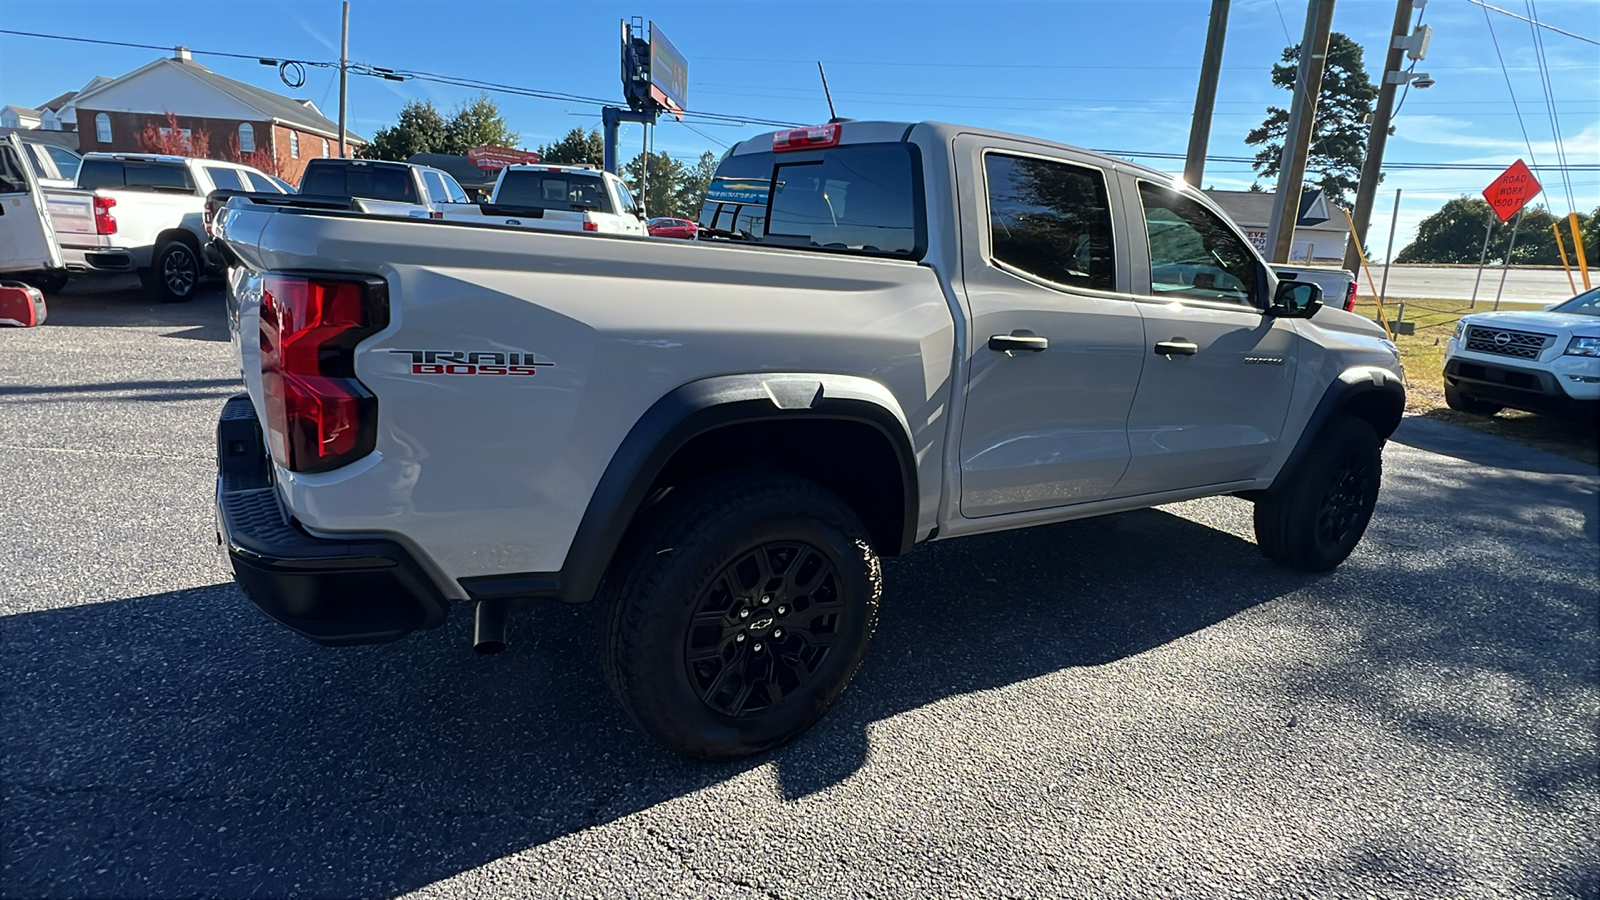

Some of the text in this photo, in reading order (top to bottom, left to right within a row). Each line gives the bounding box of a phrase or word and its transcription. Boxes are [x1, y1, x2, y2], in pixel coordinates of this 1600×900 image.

[1502, 174, 1527, 184] ROAD
[1500, 186, 1524, 195] WORK
[1494, 198, 1525, 207] 1500 FT
[388, 350, 555, 366] TRAIL
[411, 364, 536, 377] BOSS
